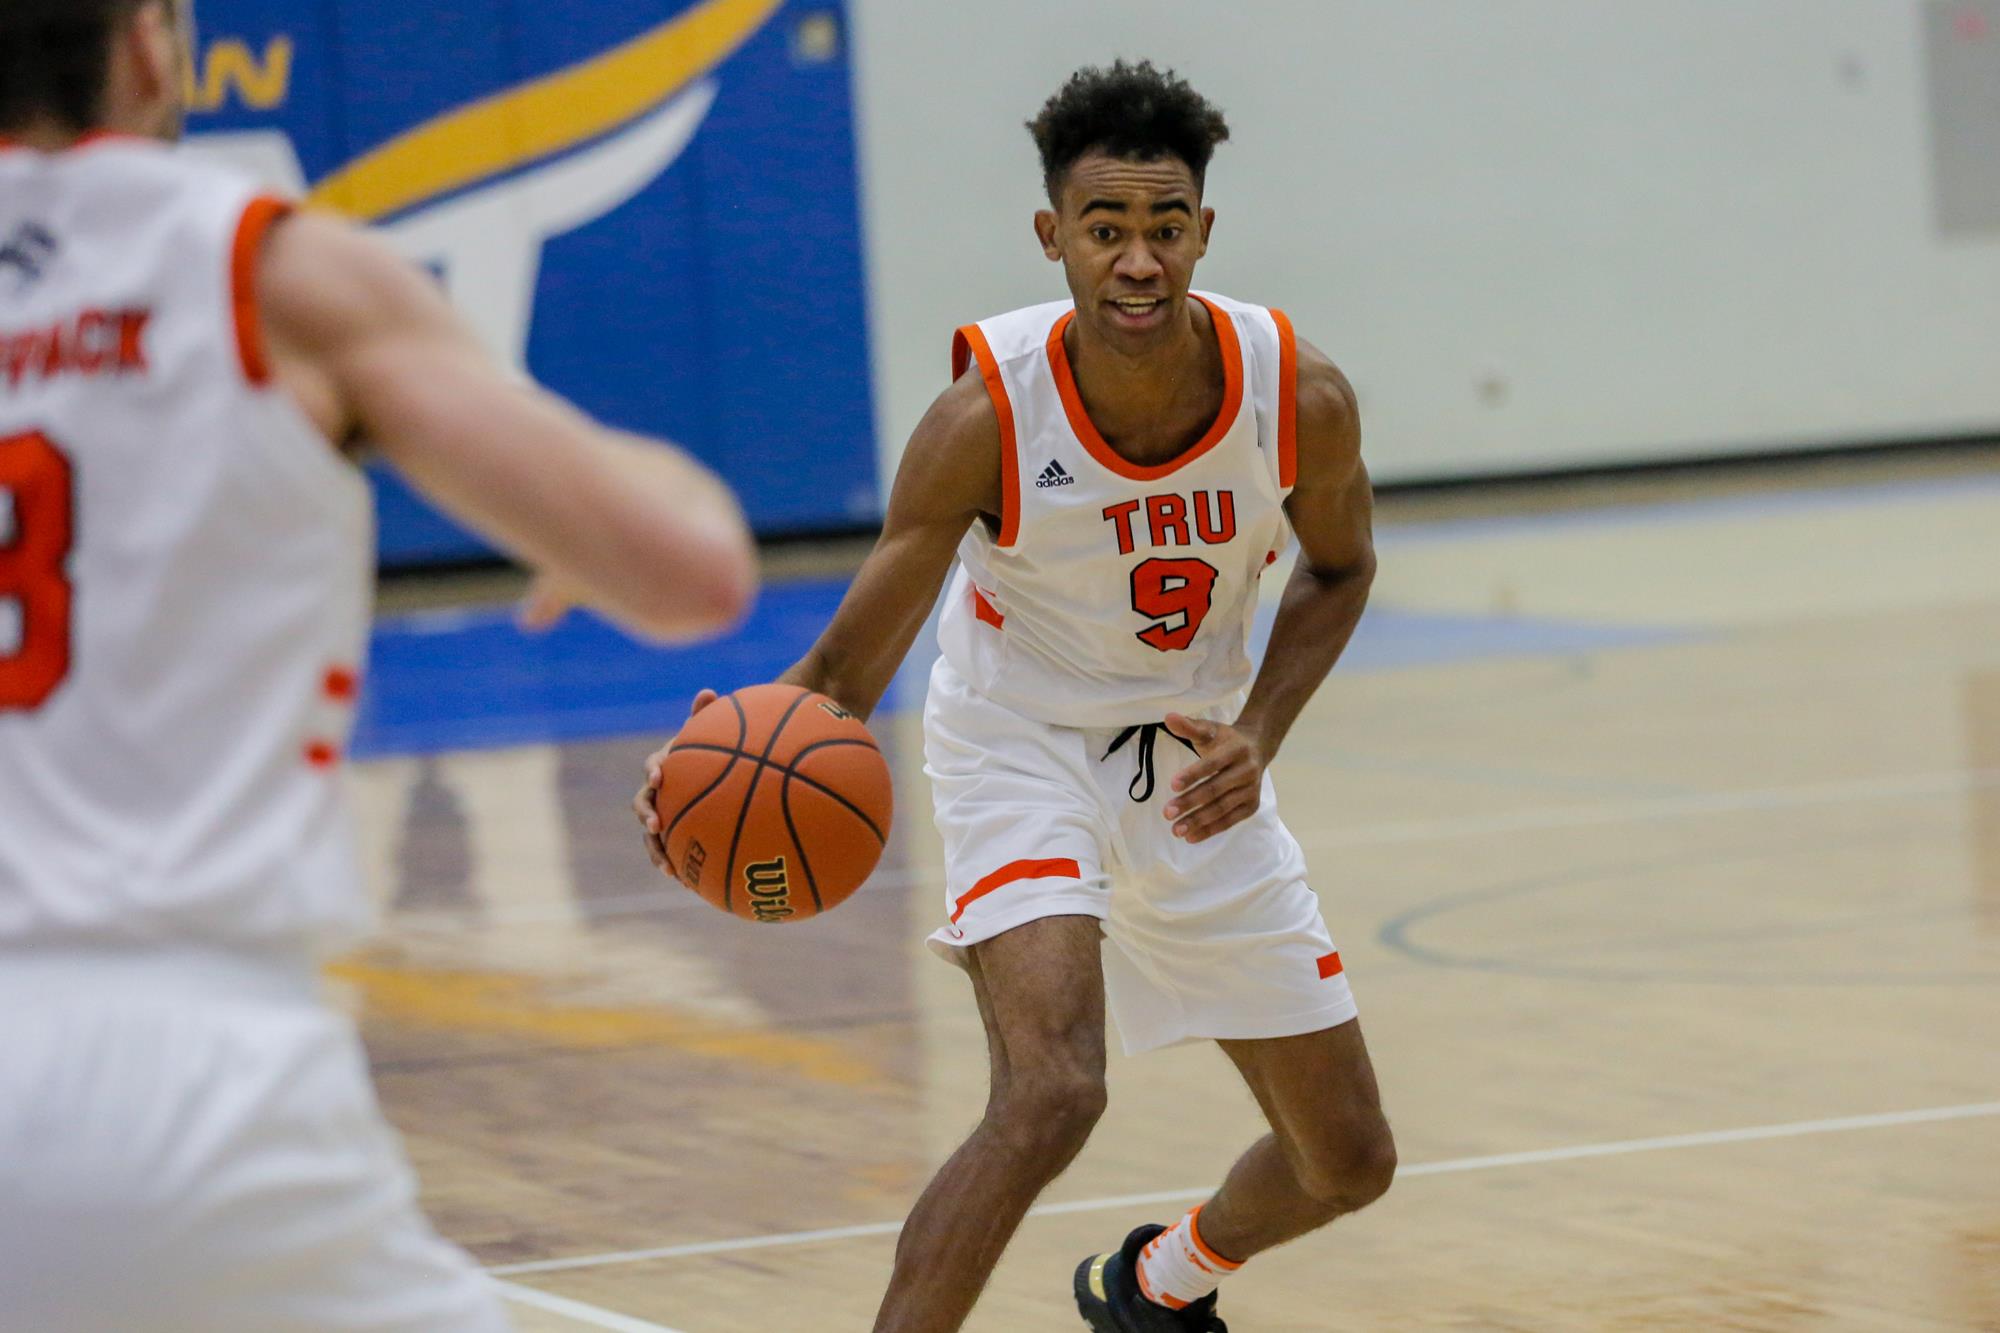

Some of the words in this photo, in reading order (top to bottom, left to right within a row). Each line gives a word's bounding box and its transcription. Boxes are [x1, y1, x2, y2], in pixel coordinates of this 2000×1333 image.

[1036, 476, 1074, 488] adidas
[1102, 490, 1236, 555] TRU
[1130, 557, 1219, 652] 9
